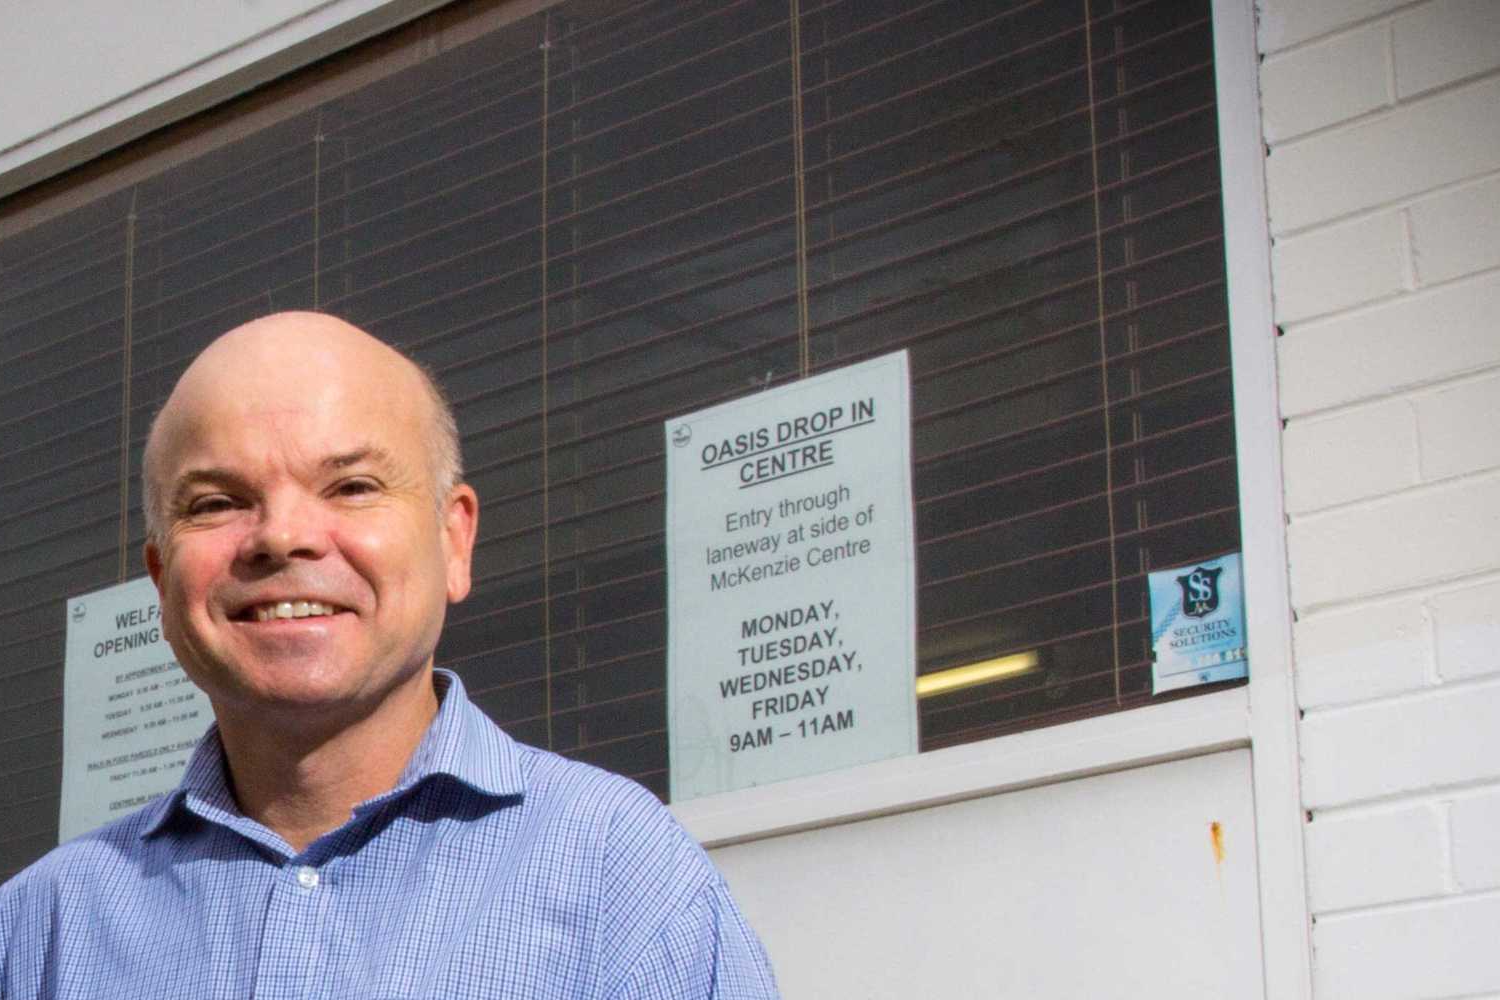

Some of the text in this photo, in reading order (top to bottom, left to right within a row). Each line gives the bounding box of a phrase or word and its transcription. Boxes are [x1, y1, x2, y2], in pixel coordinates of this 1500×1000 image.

[701, 397, 874, 466] OASIS DROP IN
[739, 440, 833, 484] CENTRE
[725, 484, 850, 533] Entry through
[707, 504, 874, 565] laneway at side of
[711, 538, 871, 591] McKenzie Centre
[741, 600, 839, 639] MONDAY,
[1169, 627, 1237, 649] SOLUTIONS
[1173, 617, 1230, 638] SECURITY
[93, 627, 160, 659] OPENING
[738, 627, 843, 666] TUESDAY,
[719, 651, 862, 699] WEDNESDAY,
[752, 686, 829, 720] FRIDAY
[729, 726, 773, 752] 9AM
[798, 709, 854, 739] 11AM
